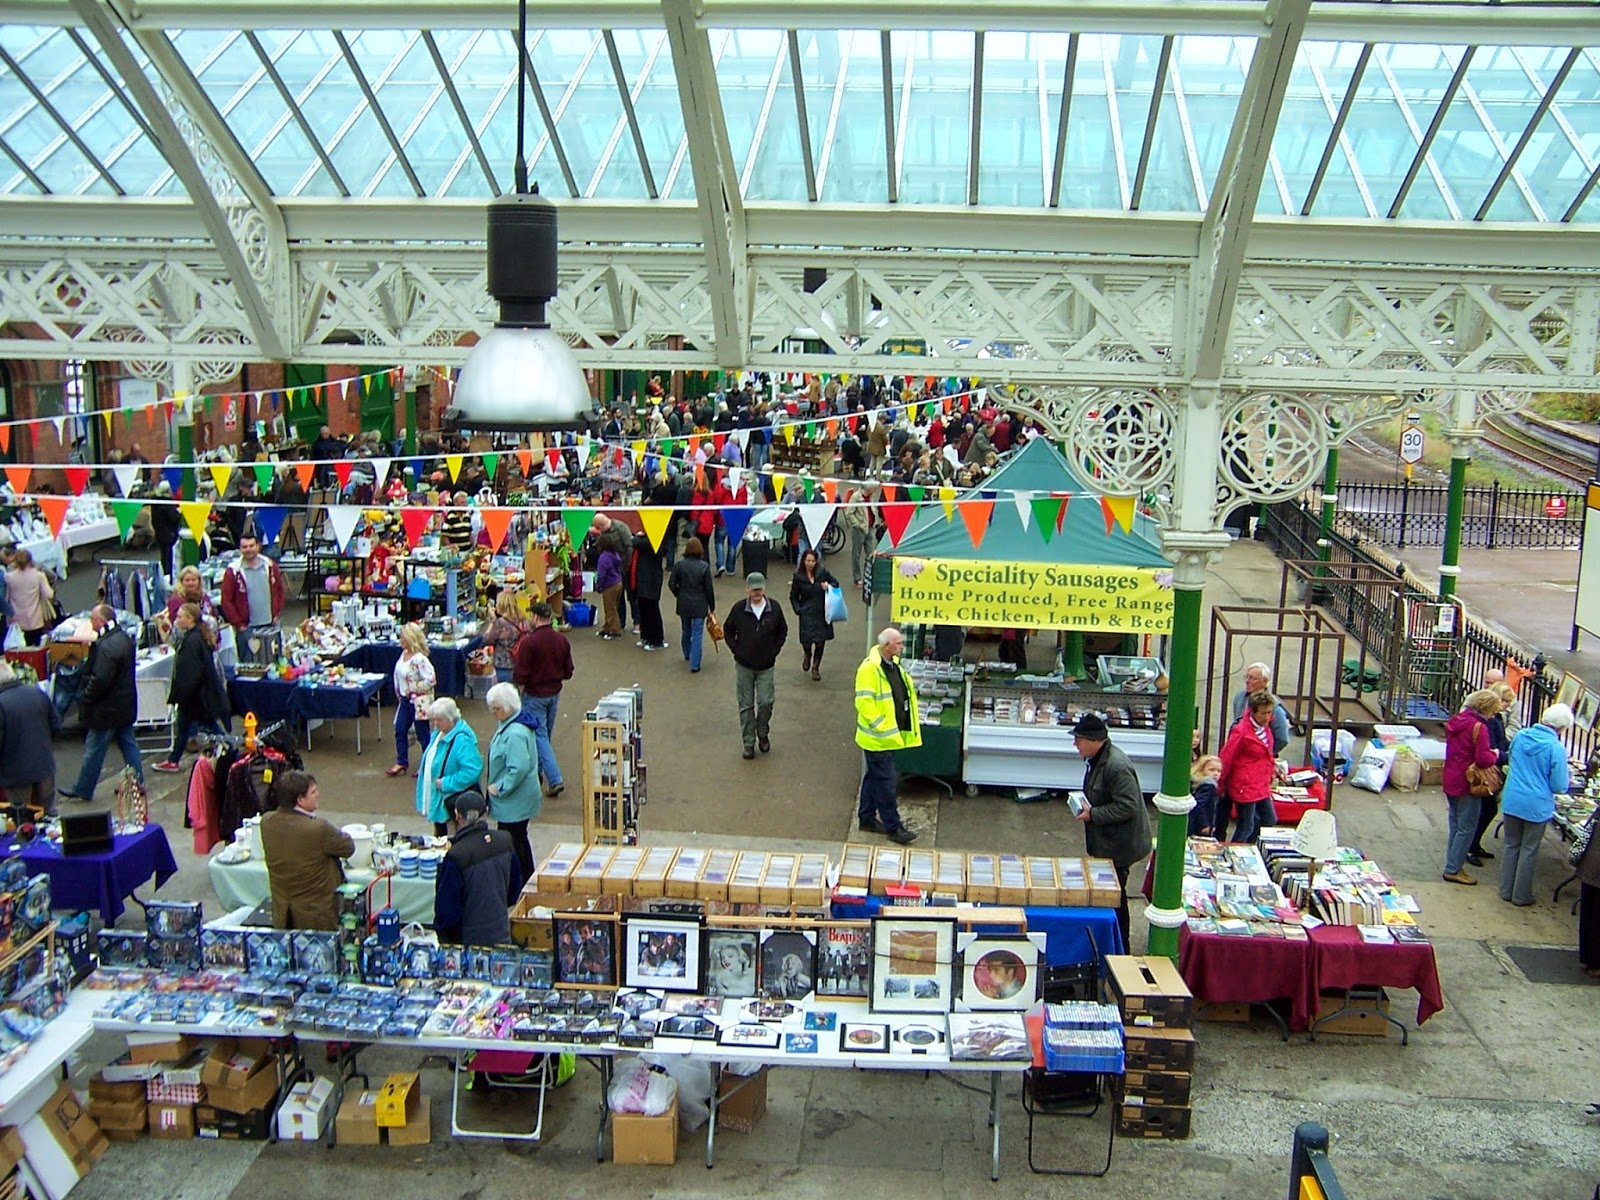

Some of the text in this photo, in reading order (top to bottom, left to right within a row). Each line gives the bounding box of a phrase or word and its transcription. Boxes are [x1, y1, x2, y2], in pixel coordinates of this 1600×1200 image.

[1404, 434, 1421, 446] 30
[936, 563, 1138, 594] Speciality Sausages
[900, 587, 1174, 613] Home Produced, Free Range
[899, 604, 1174, 629] Pork, Chicken, Lamb & Beef
